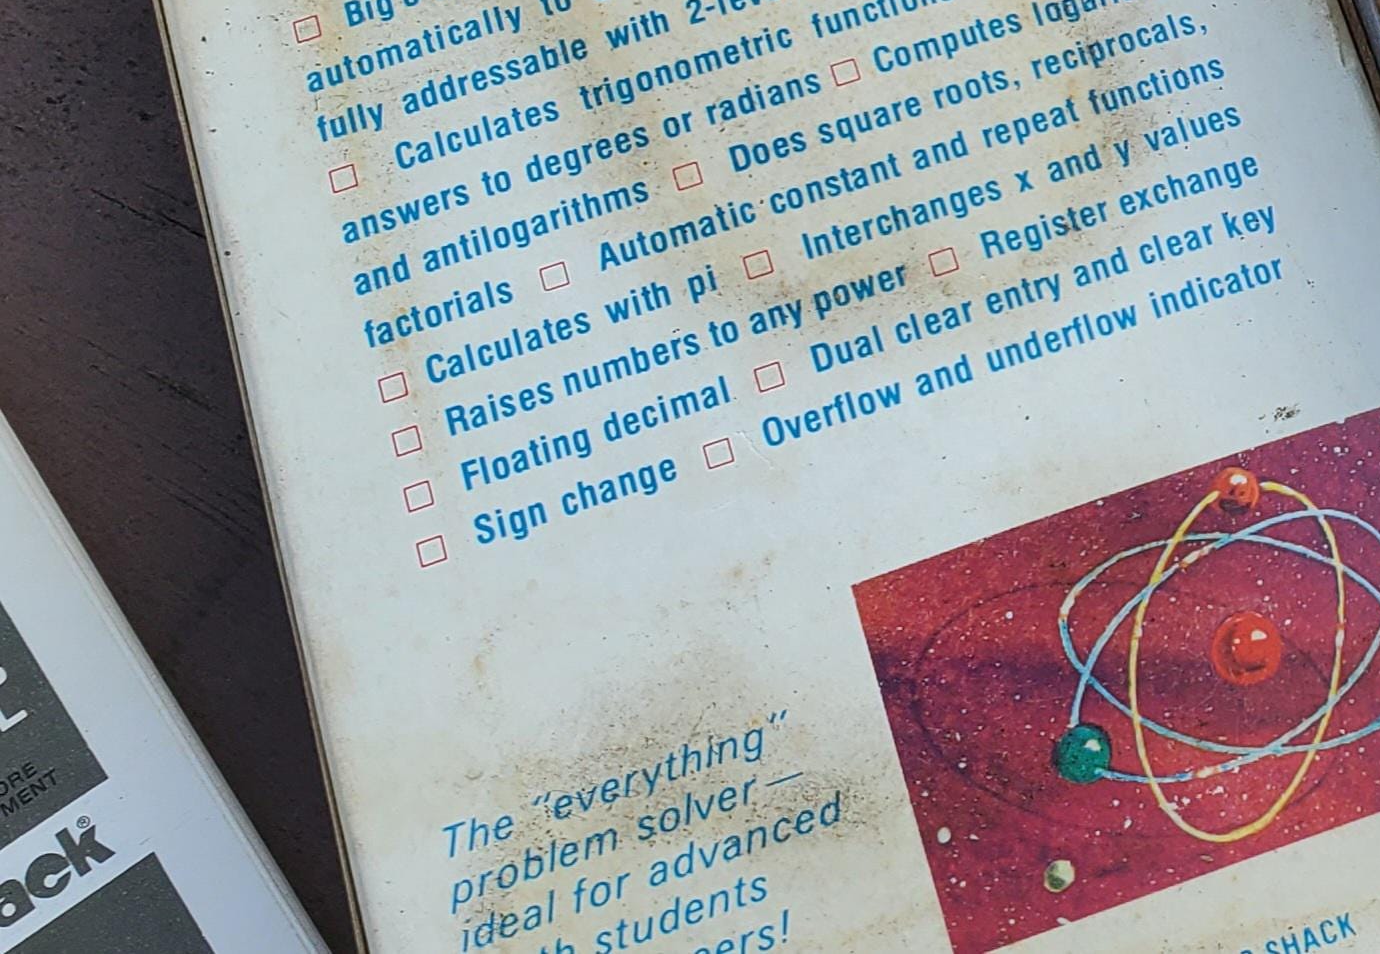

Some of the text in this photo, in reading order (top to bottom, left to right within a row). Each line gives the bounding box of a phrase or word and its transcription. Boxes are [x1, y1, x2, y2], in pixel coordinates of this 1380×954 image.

[305, 3, 523, 93] automatically
[316, 101, 385, 142] fully
[402, 36, 588, 116] addressable
[605, 11, 670, 50] with
[341, 182, 471, 244] answers
[481, 169, 512, 197] to
[525, 122, 650, 185] degrees
[663, 111, 693, 139] or
[706, 70, 822, 125] radians
[872, 8, 1023, 74] Computes
[395, 98, 560, 170] Calculates
[579, 23, 793, 113] trigonometric
[353, 12, 1208, 296] and antilogarithms Does square roots, reciprocals,
[364, 55, 1225, 348] factorials Automatic constant and repeat functions
[424, 105, 1243, 384] Calculates with pi Interchanges x and y values
[444, 154, 1260, 436] Raises numbers to any power Register exchange
[459, 202, 1278, 491] Floating decimal Dual clear entry and clear key
[472, 256, 1285, 546] Sign change Overflow and underflow indicator
[441, 810, 514, 860] The
[450, 825, 619, 916] problem
[462, 790, 842, 953] ideal for advanced
[596, 875, 769, 954] students
